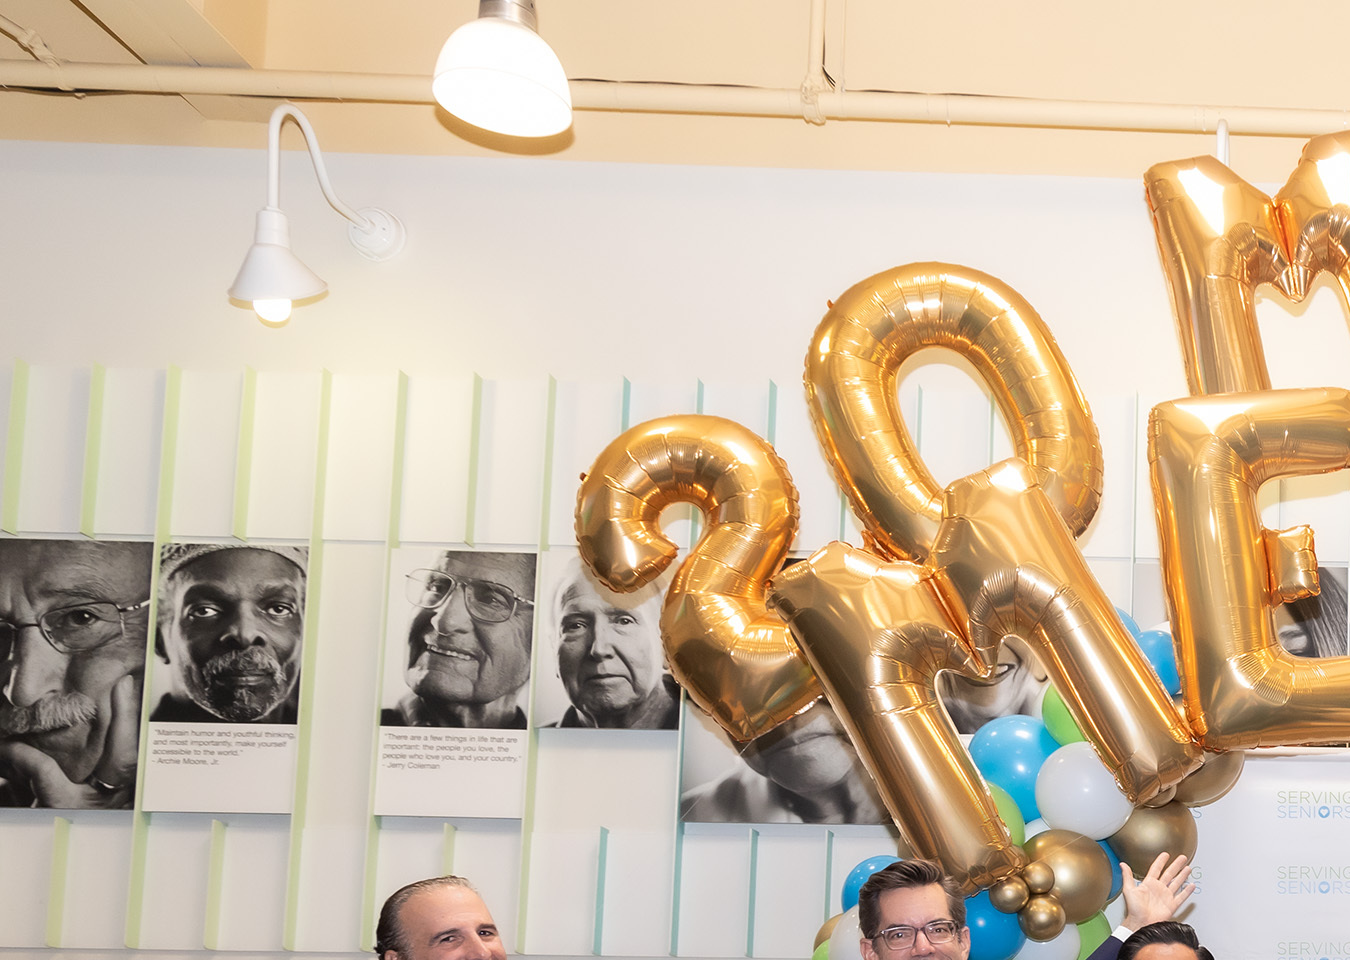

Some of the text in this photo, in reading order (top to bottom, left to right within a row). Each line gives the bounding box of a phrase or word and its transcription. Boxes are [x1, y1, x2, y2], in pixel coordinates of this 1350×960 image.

[574, 261, 1104, 741] 20
[445, 735, 467, 743] things
[387, 762, 405, 770] Jerry
